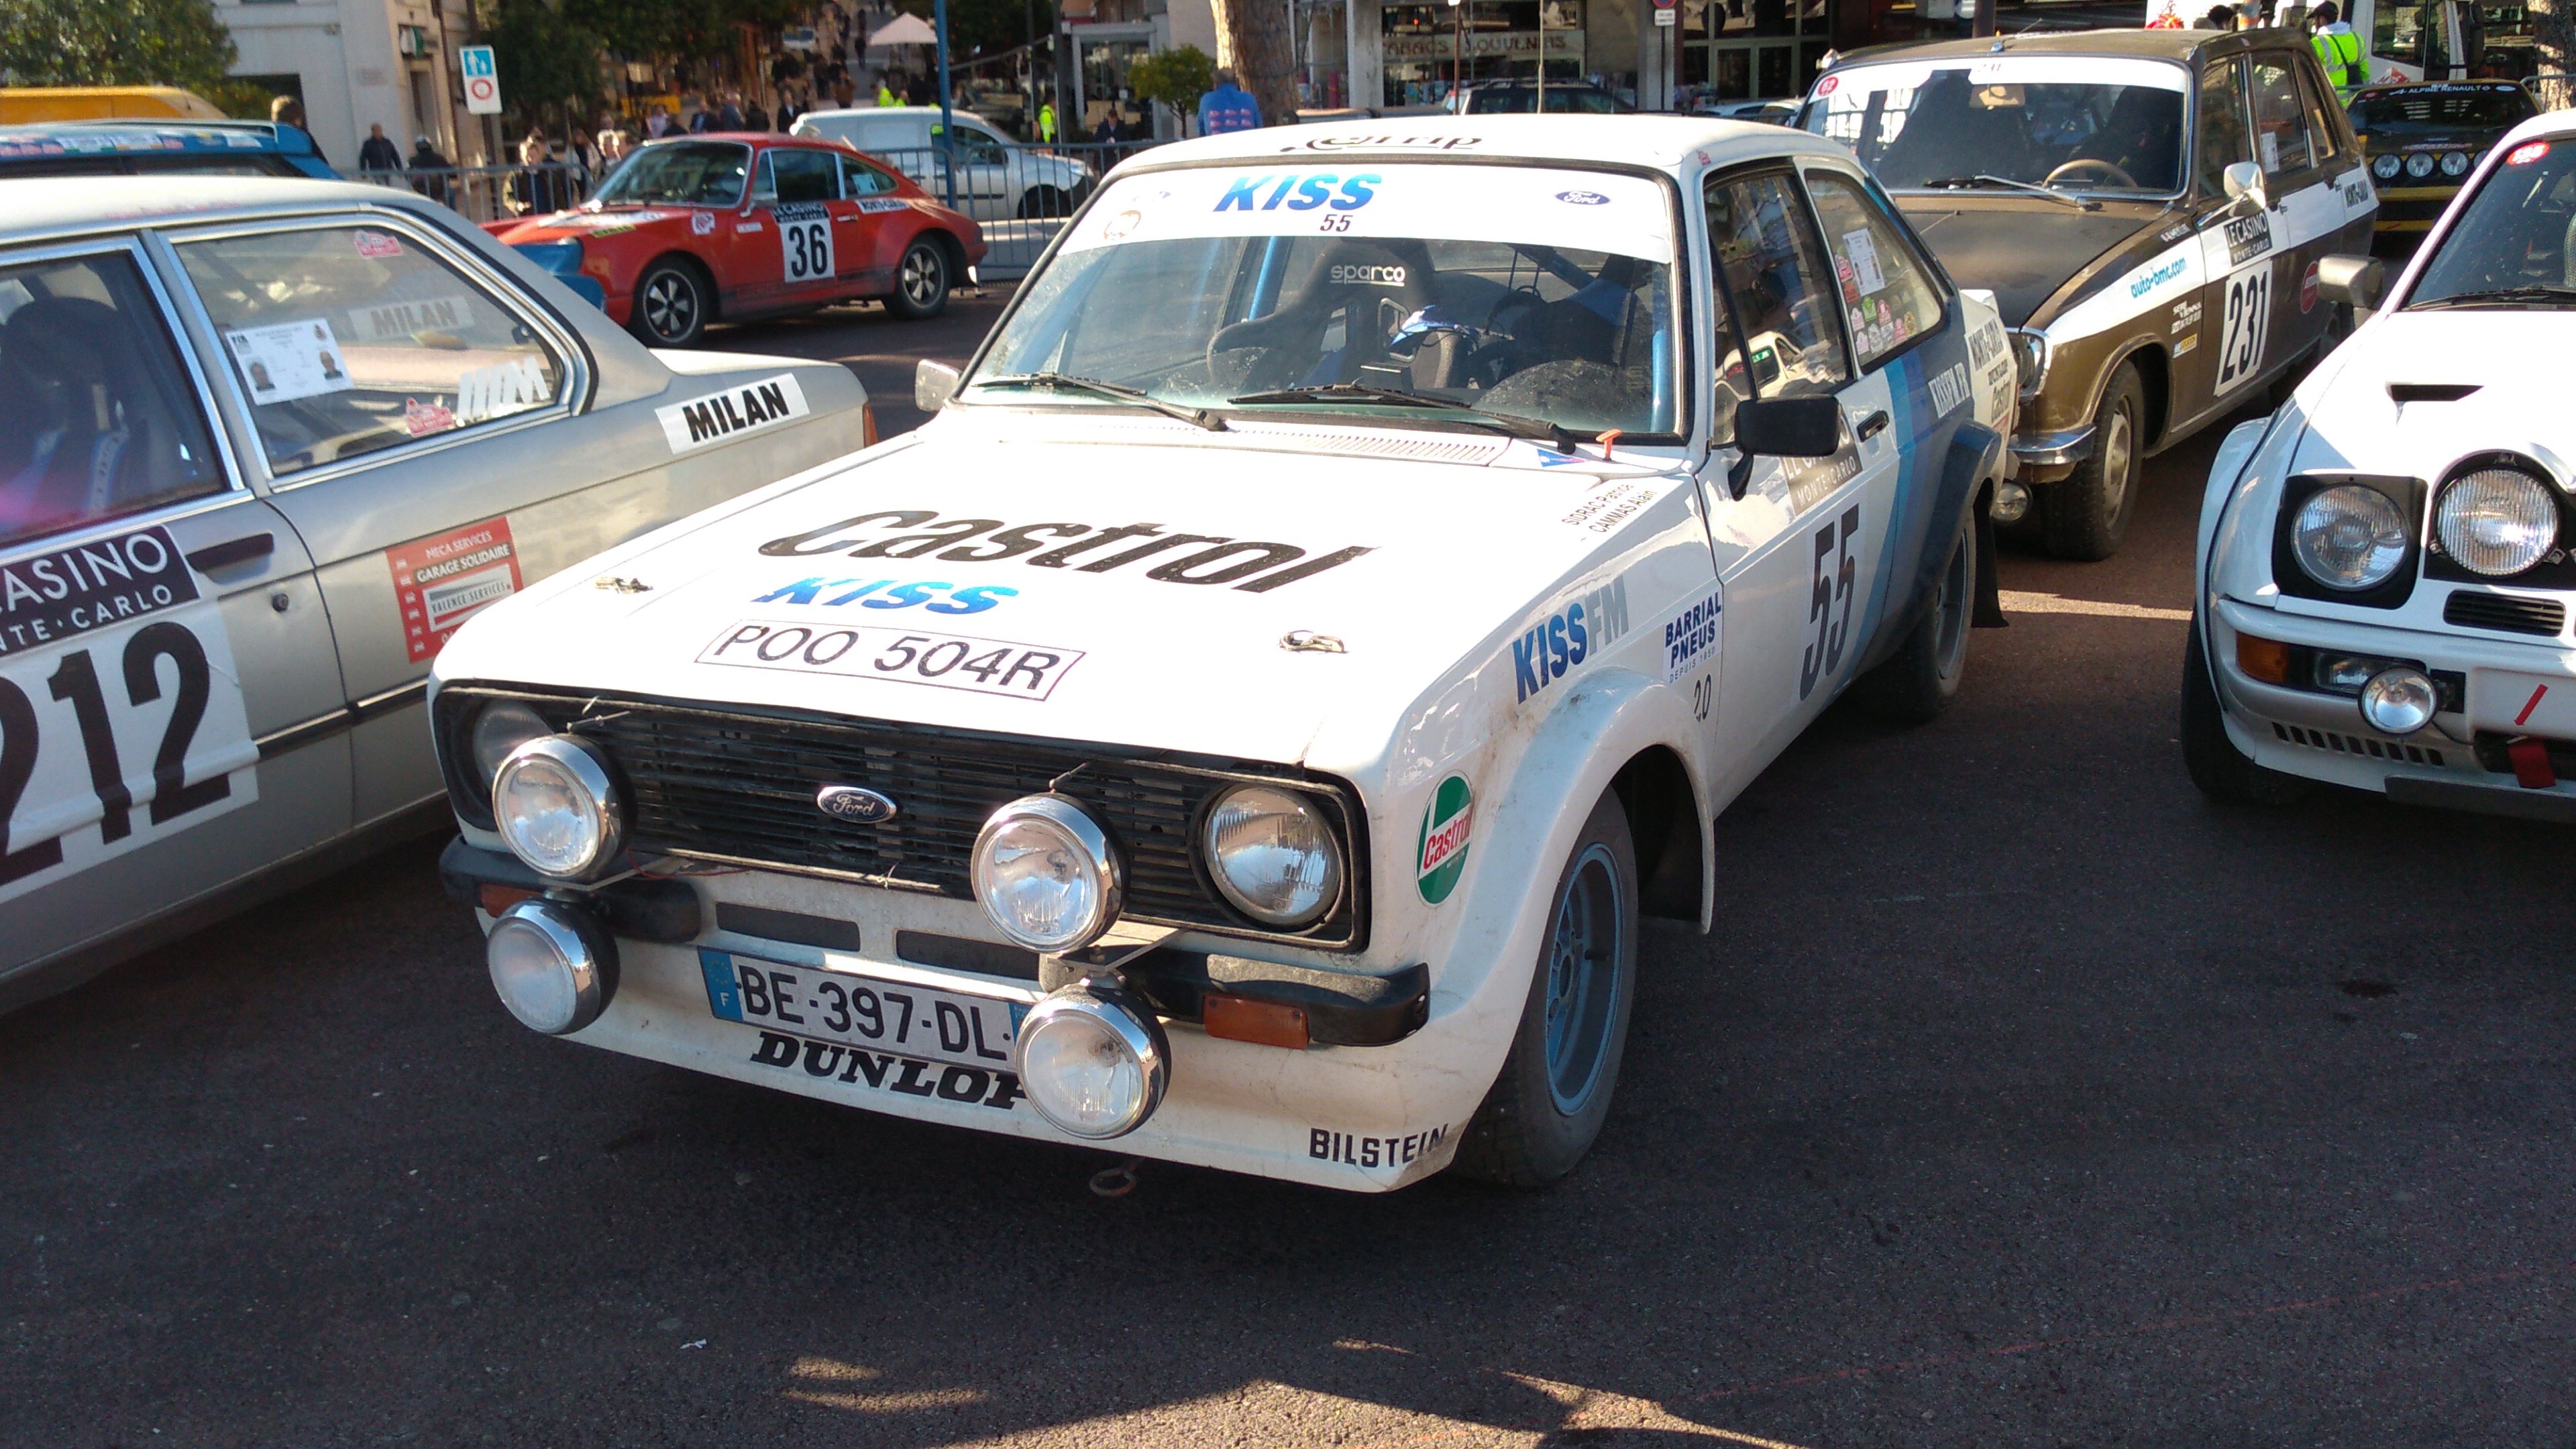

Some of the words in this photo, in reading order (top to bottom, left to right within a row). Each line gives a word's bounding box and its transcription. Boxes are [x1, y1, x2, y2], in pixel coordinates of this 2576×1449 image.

[1212, 173, 1383, 211] KISS
[1564, 191, 1601, 203] Ford
[1320, 214, 1353, 231] 55
[2237, 211, 2267, 242] CASINO
[788, 224, 828, 277] 36
[1330, 265, 1405, 284] sparco
[2130, 256, 2188, 299] auto-bmc.com
[371, 301, 459, 336] MILAN
[2219, 270, 2267, 384] 231
[681, 382, 790, 443] MILAN
[1562, 501, 1606, 525] SIDRAC
[1589, 504, 1638, 533] CAMMAS
[416, 561, 460, 583] GARAGE
[461, 543, 511, 570] SOLIDAIRE
[426, 545, 453, 559] MECA
[453, 530, 493, 551] SERVICES
[758, 510, 1381, 593] Castrol
[0, 533, 168, 613] ASINO
[431, 595, 467, 614] VALENCE
[469, 582, 506, 602] SERVICES
[749, 576, 1020, 614] KISS
[1800, 502, 1859, 701] 55
[1665, 591, 1721, 648] BARRIAL
[873, 635, 1061, 691] 504R
[1671, 619, 1715, 669] PNEUS
[1670, 658, 1697, 684] DEPUIS
[0, 621, 231, 884] 212
[833, 794, 875, 817] Ford
[1423, 807, 1472, 870] Castrol
[720, 991, 729, 1007] F
[739, 964, 1008, 1061] BE-397-DL
[750, 1031, 1027, 1110] DUNLOP
[1309, 1122, 1449, 1168] BILSTEIN
